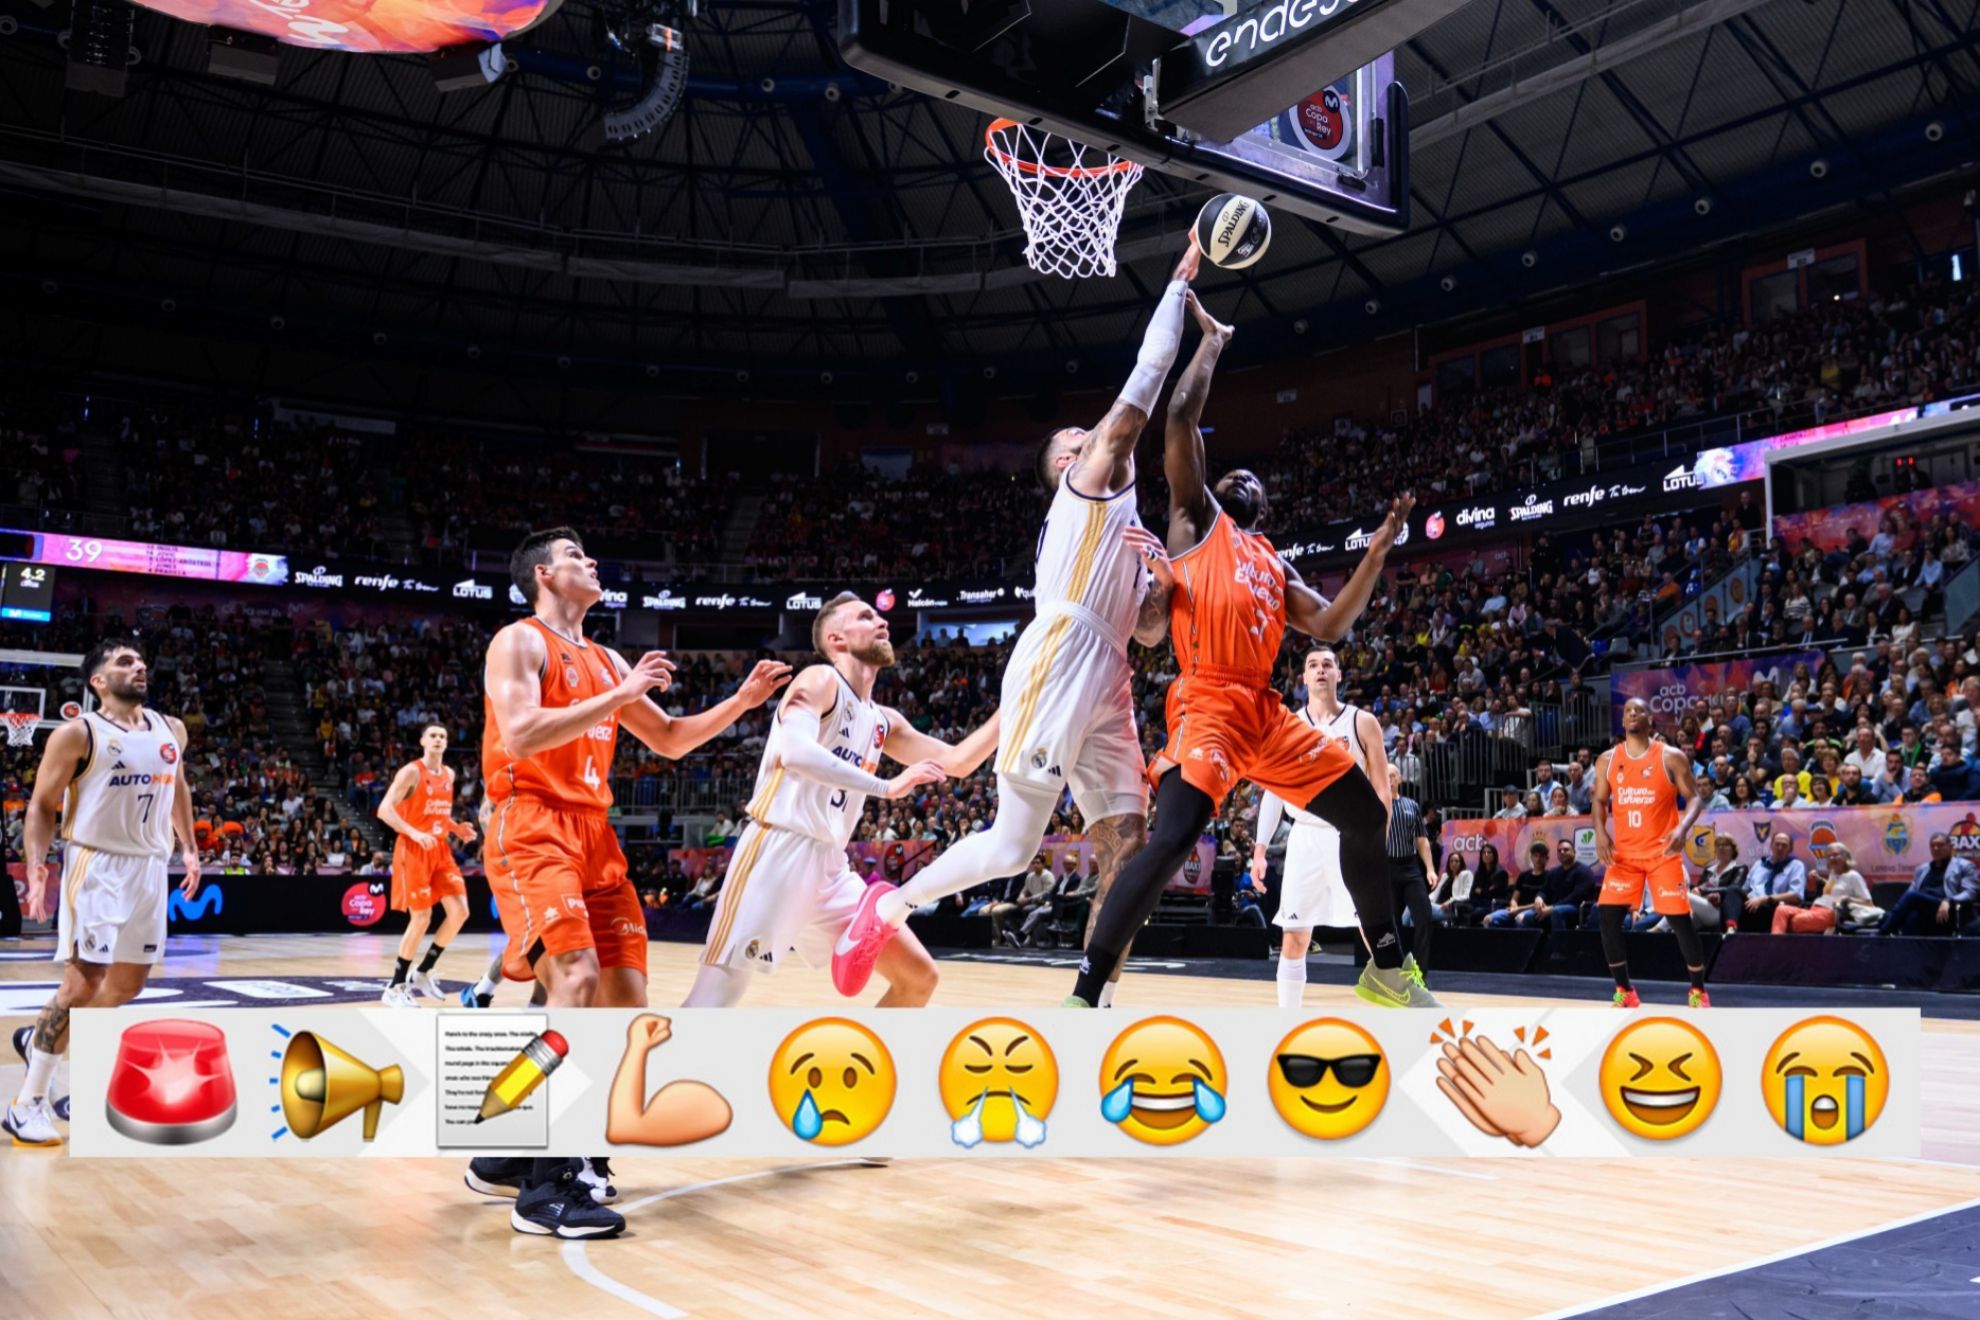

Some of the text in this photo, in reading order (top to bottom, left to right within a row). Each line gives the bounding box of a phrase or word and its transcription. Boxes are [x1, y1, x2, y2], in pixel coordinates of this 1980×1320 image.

[1206, 0, 1358, 67] ende
[1305, 108, 1328, 124] Copa
[1316, 121, 1331, 136] Rey
[1217, 200, 1250, 248] SPALDING
[1563, 486, 1605, 507] renfe
[1456, 507, 1495, 526] divina
[1510, 500, 1553, 521] SPALDING
[66, 538, 103, 563] 39
[1345, 537, 1371, 551] LOTU
[20, 567, 46, 581] 4.2
[295, 572, 343, 587] SPALDING
[354, 574, 399, 591] renfe
[453, 585, 493, 599] LOTUS
[601, 589, 628, 602] vina
[696, 593, 736, 609] renfe
[786, 600, 822, 609] LOTUS
[1660, 682, 1686, 697] acb
[584, 755, 600, 790] 4
[138, 794, 154, 824] 7
[1628, 810, 1642, 828] 10
[432, 821, 443, 835] 6
[1950, 836, 1980, 849] BAX
